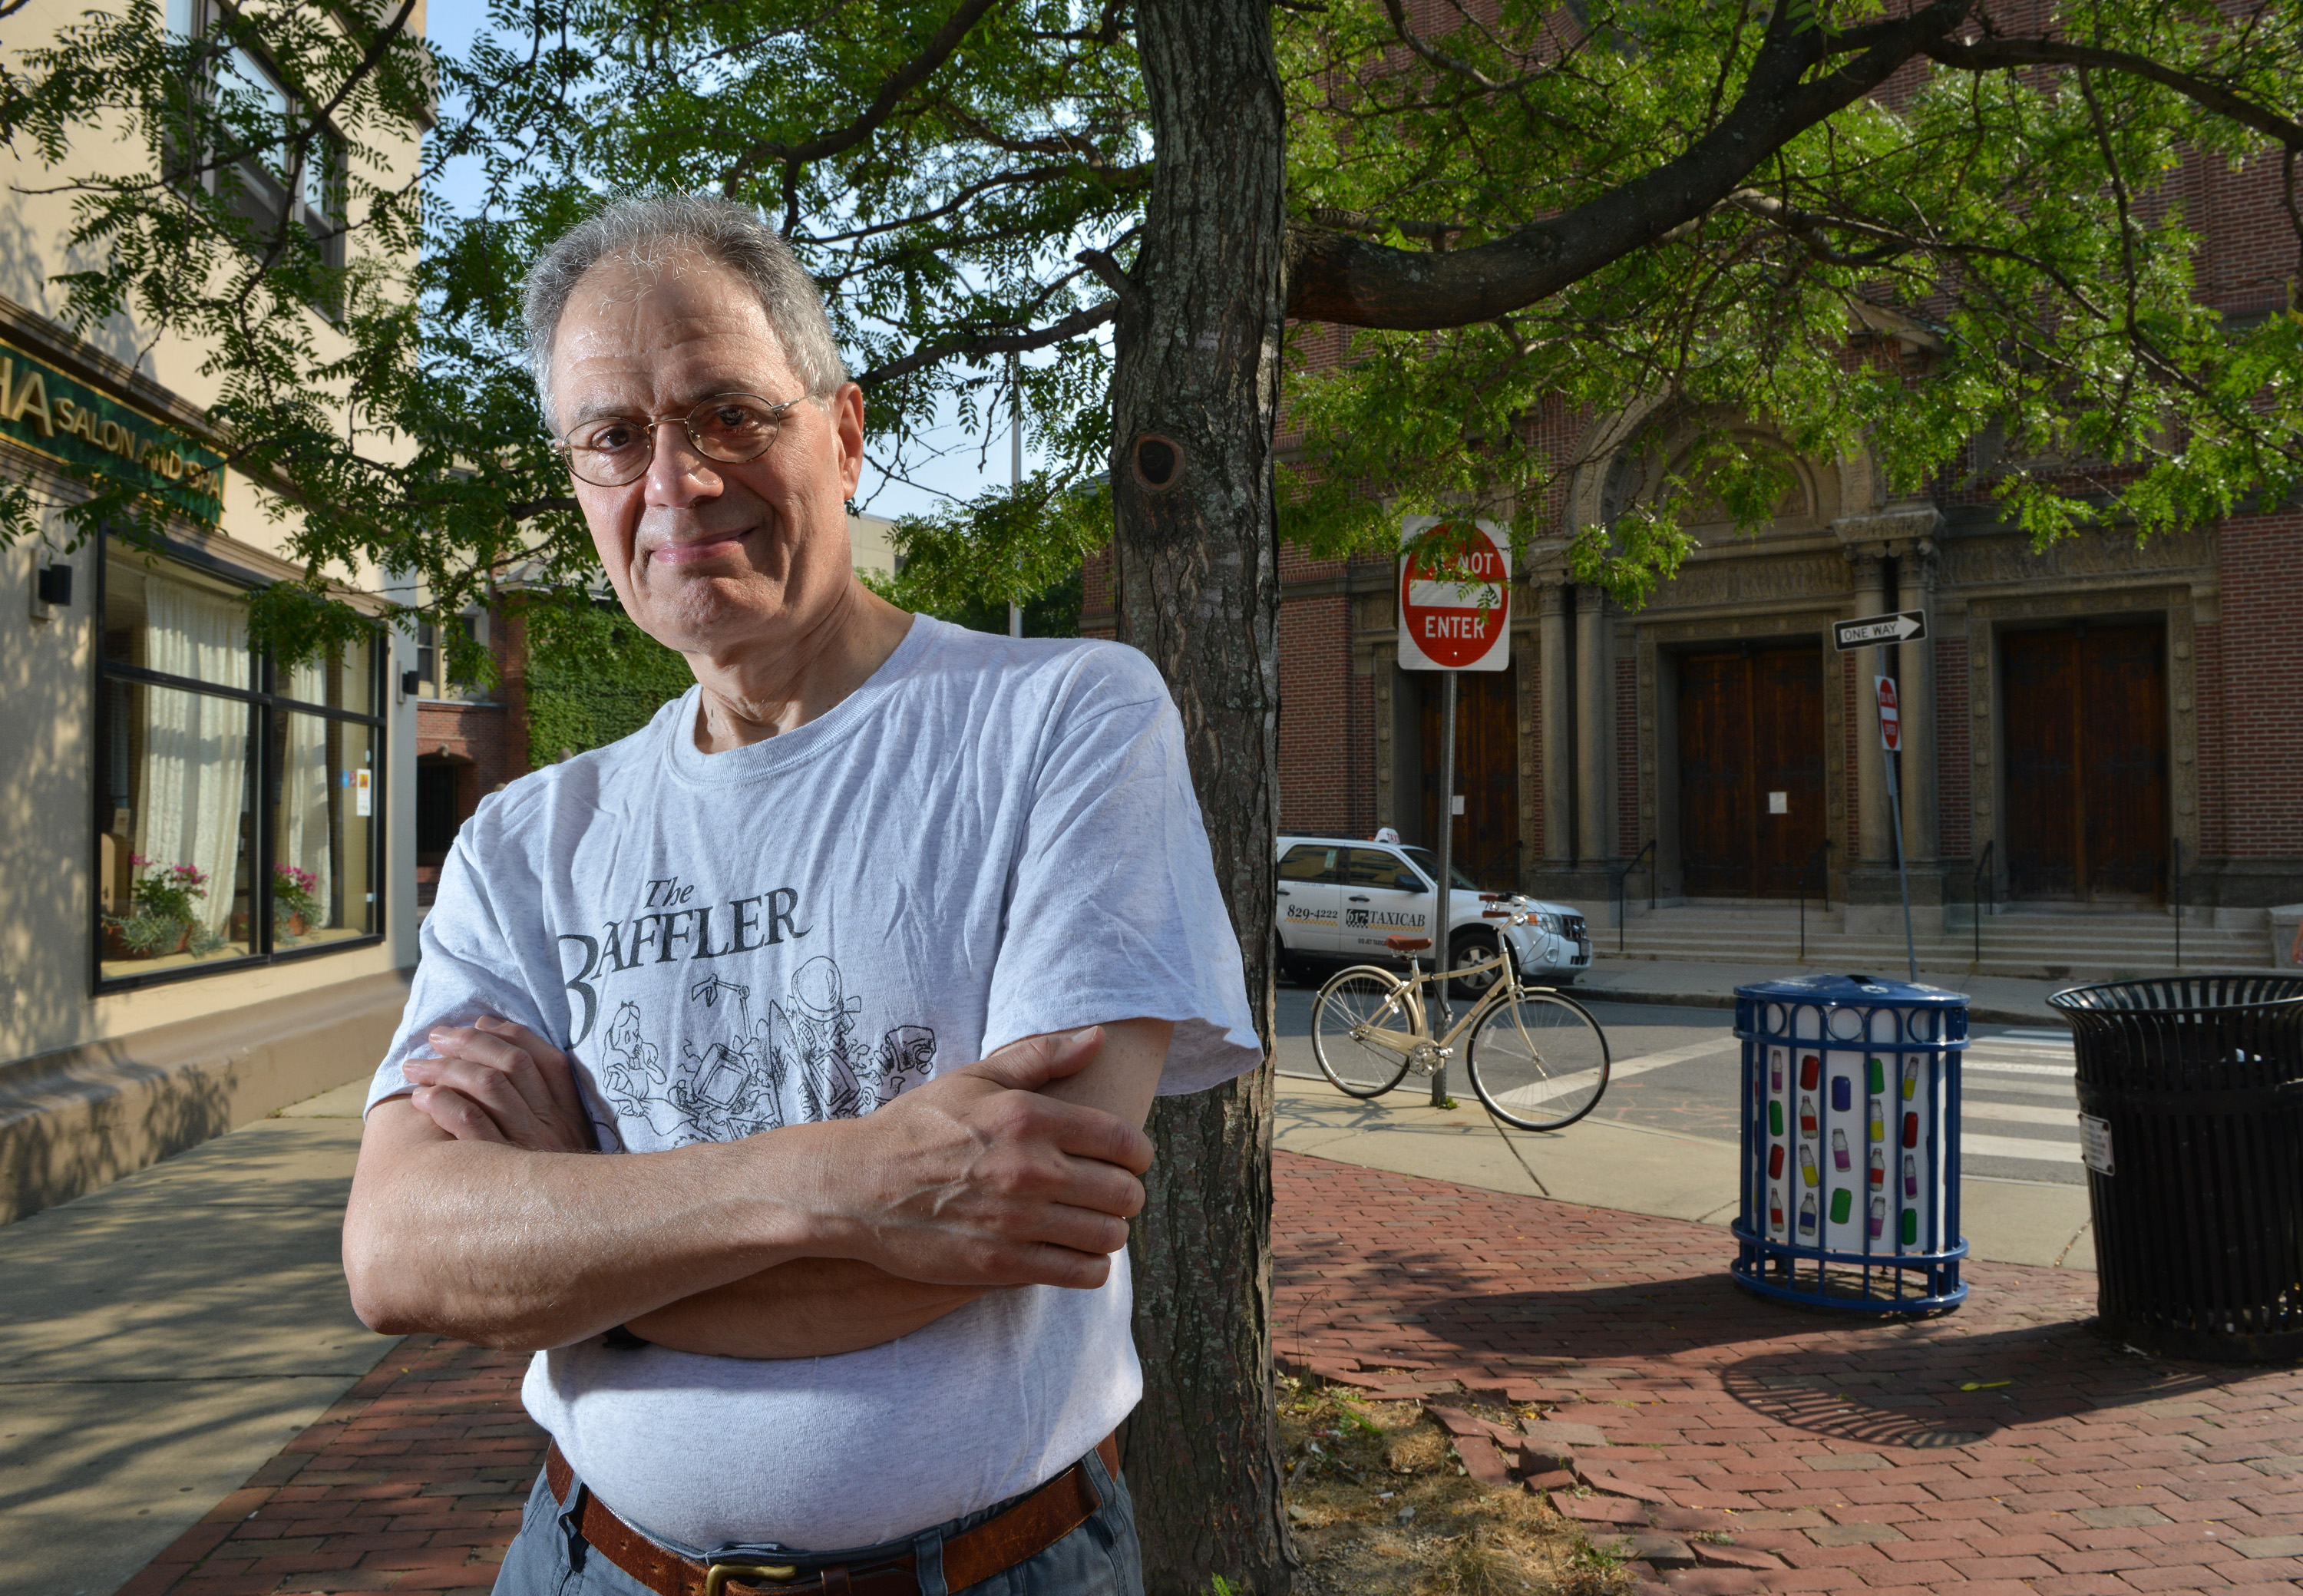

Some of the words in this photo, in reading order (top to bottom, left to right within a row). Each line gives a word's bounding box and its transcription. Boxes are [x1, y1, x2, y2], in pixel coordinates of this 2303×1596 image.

[53, 397, 136, 460] SALON
[183, 461, 221, 501] SPA
[1458, 552, 1494, 574] NOT
[1426, 616, 1485, 639] ENTER
[1844, 627, 1869, 641] ONE
[1872, 623, 1897, 636] WAY
[643, 877, 695, 909] The
[1287, 904, 1338, 920] 829-4222
[556, 887, 814, 1052] BAFFLER
